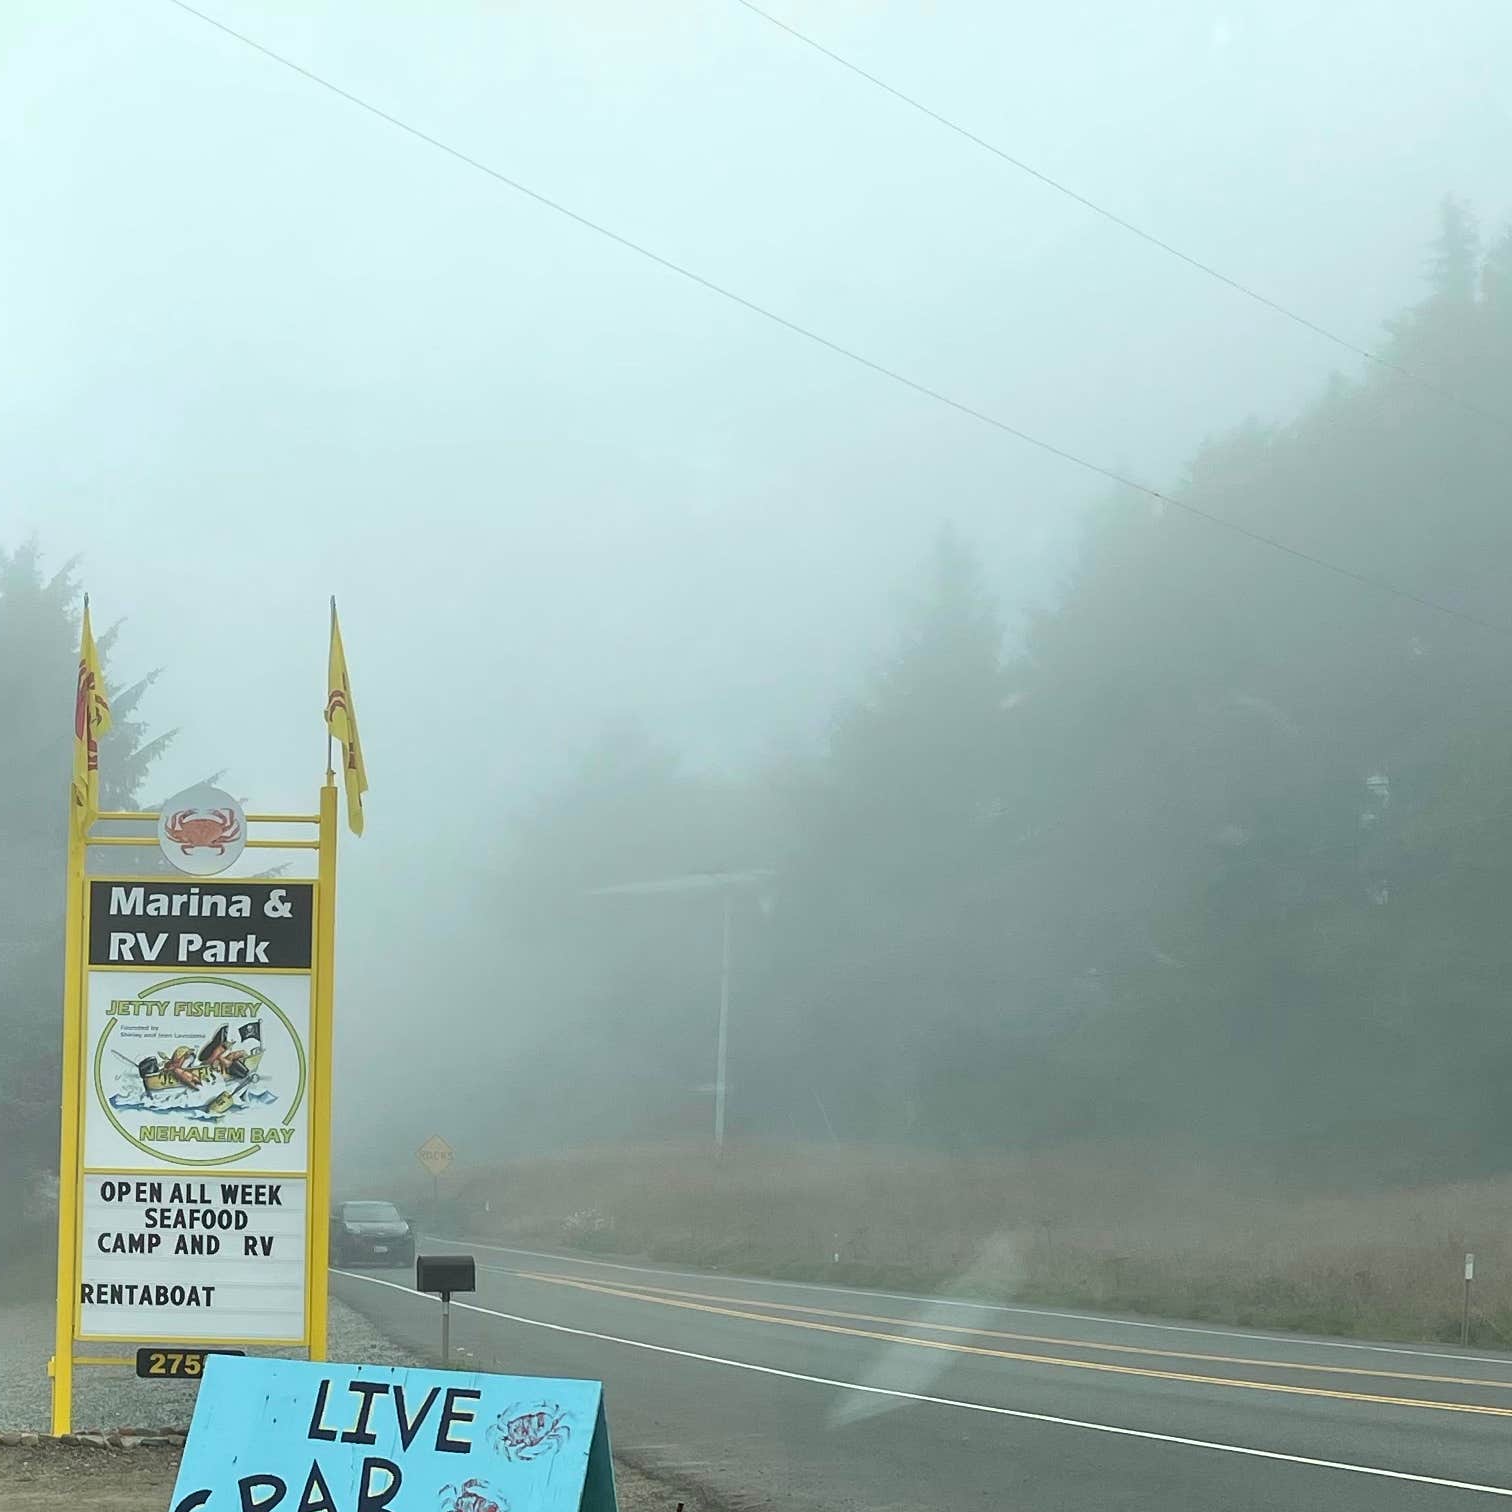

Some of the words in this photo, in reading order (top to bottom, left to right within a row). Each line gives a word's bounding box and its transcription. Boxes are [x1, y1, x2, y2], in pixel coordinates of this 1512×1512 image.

[109, 887, 252, 917] Marina
[263, 889, 293, 918] &
[109, 933, 168, 962] RV
[178, 935, 270, 964] Park
[106, 1000, 170, 1016] JETTY
[174, 1001, 262, 1017] FISHERY
[140, 1126, 245, 1143] NEHALEM
[250, 1128, 295, 1144] BAY
[100, 1181, 162, 1203] OPEN
[170, 1183, 212, 1204] ALL
[221, 1184, 282, 1206] WEEK
[145, 1208, 248, 1230] SEAFOOD
[97, 1232, 161, 1254] CAMP
[174, 1234, 220, 1255] AND
[244, 1236, 274, 1256] RV
[149, 1353, 201, 1375] 275
[308, 1379, 481, 1454] LIVE
